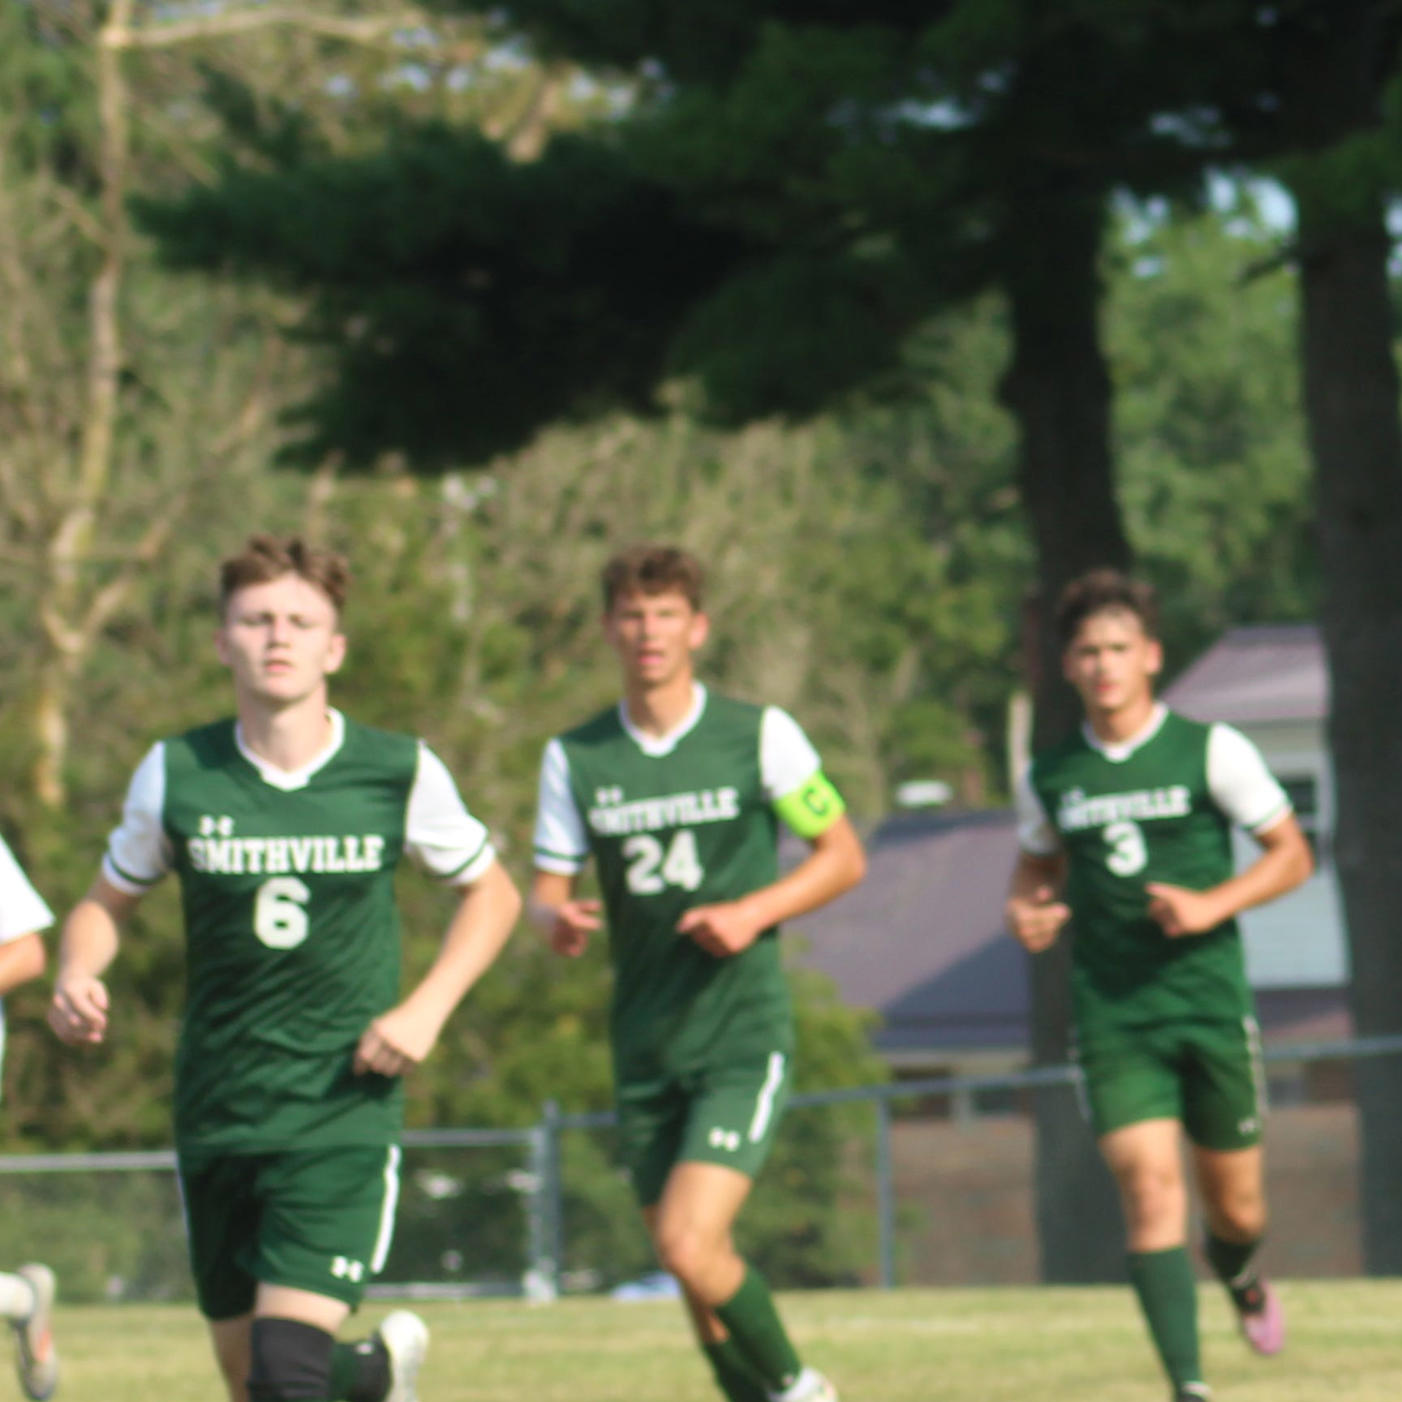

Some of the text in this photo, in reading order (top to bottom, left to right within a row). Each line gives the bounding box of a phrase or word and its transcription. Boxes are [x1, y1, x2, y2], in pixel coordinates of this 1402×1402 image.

[187, 834, 386, 875] SMITHVILLE
[622, 830, 704, 895] 24
[1102, 821, 1148, 878] 3
[253, 874, 311, 950] 6
